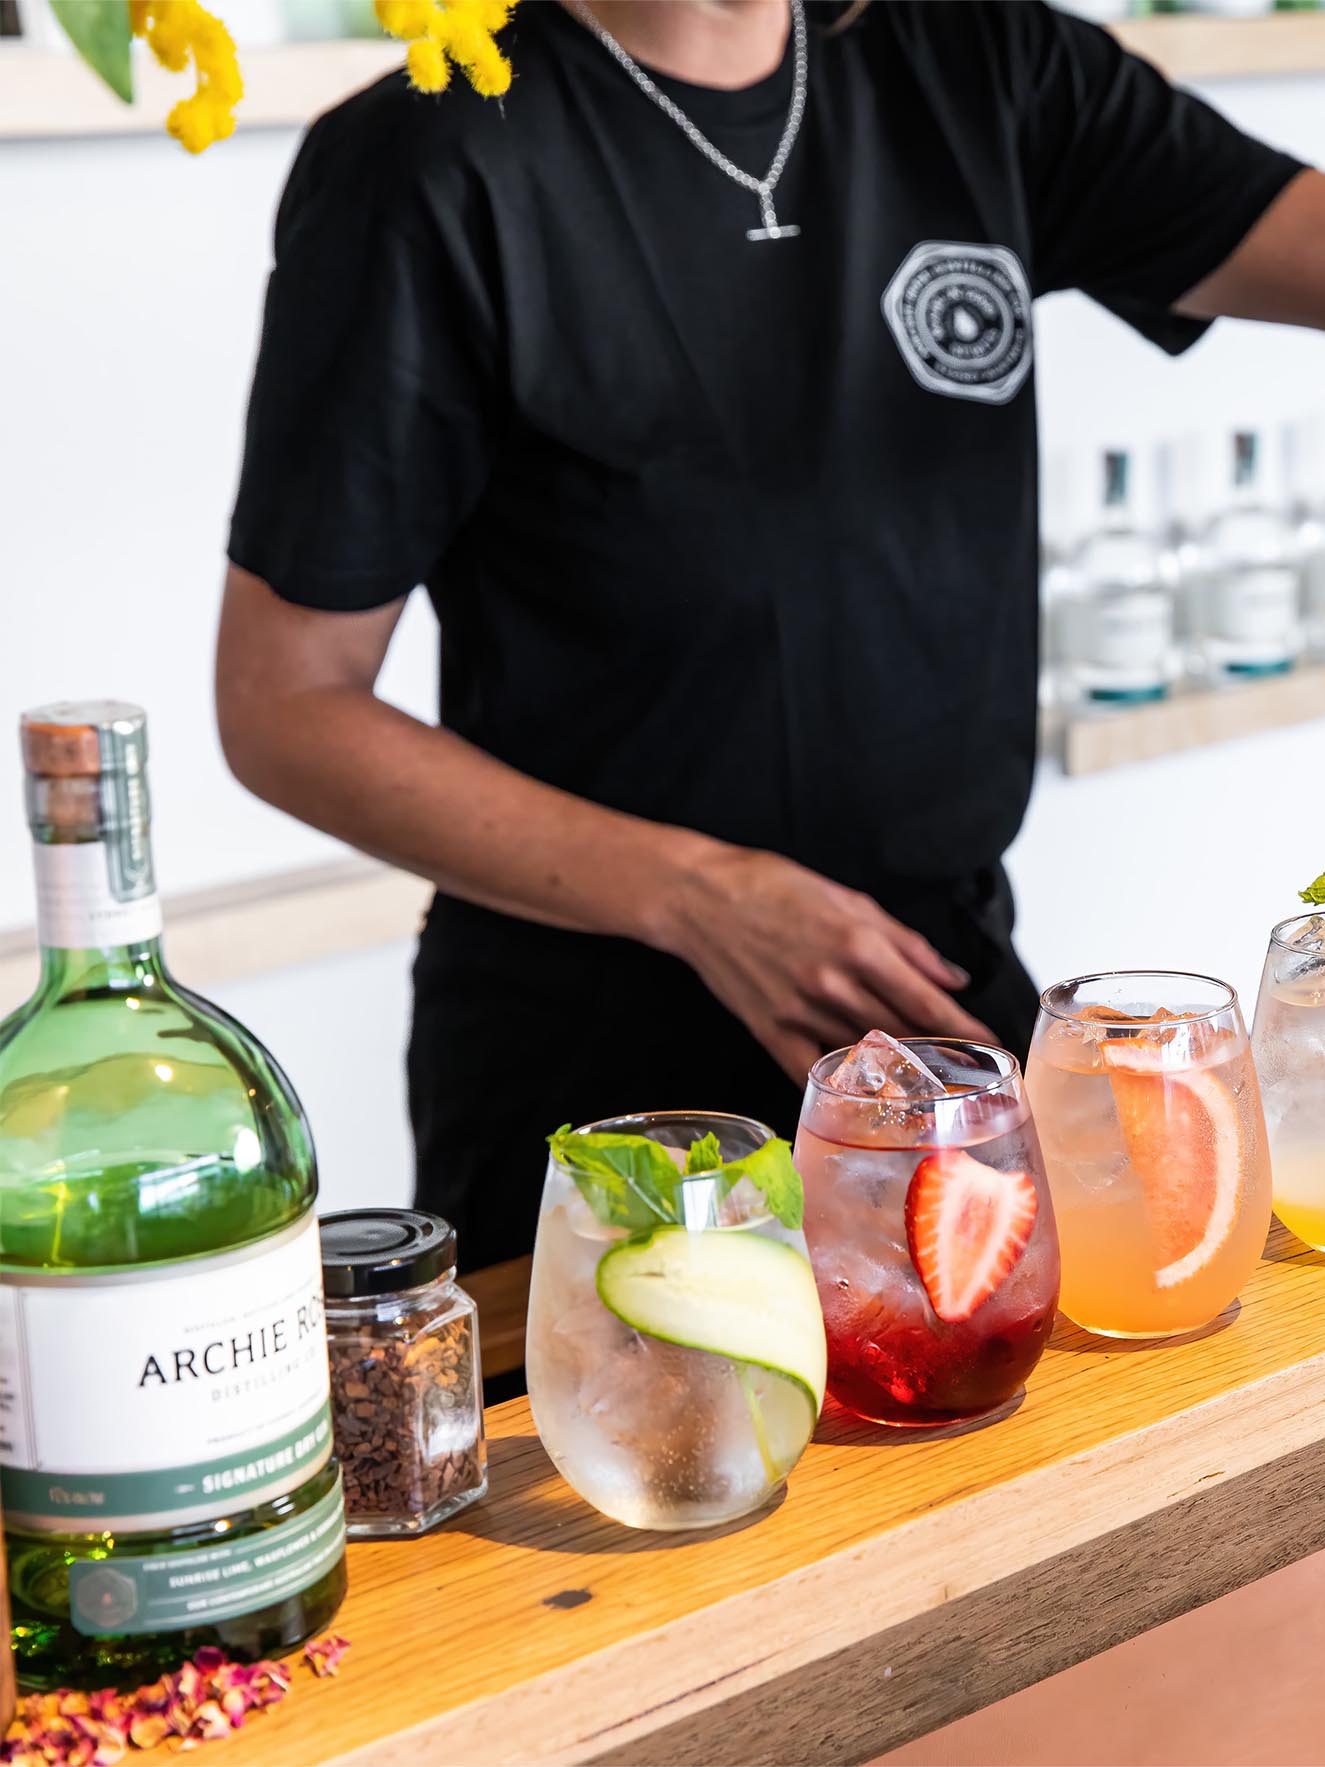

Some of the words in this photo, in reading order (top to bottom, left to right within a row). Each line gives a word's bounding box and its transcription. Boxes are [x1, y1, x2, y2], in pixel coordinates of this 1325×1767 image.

[137, 1318, 288, 1388] ARCHIE
[296, 1295, 323, 1340] RO
[210, 1358, 301, 1403] DISTILLING
[202, 1445, 294, 1495] SIGNATURE
